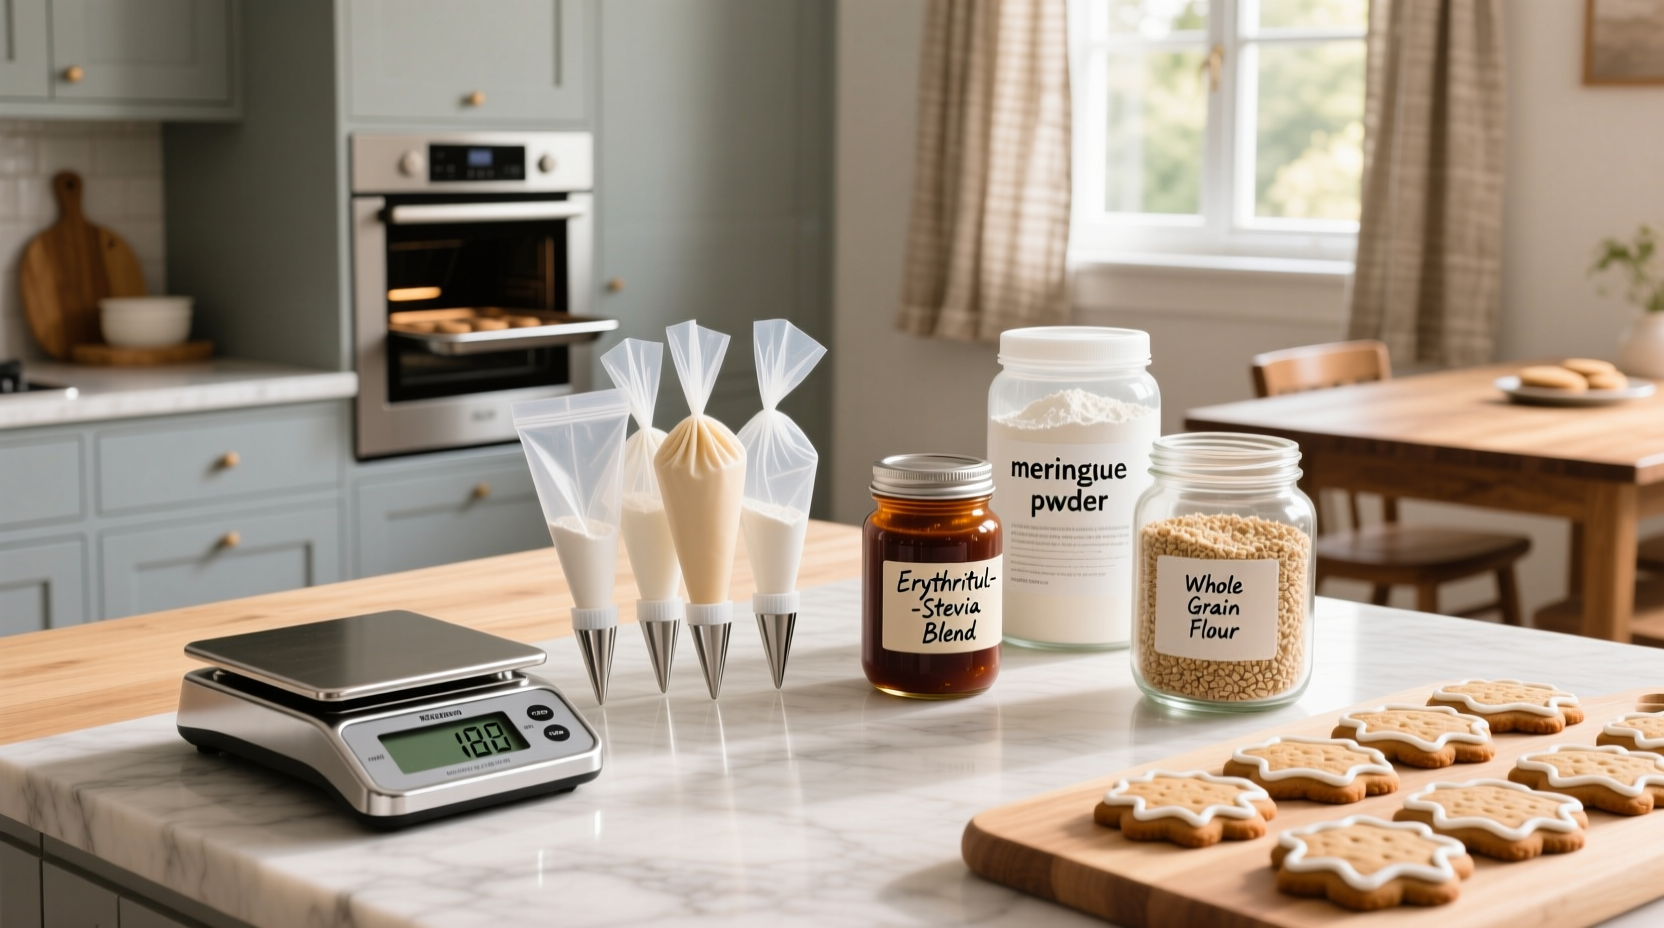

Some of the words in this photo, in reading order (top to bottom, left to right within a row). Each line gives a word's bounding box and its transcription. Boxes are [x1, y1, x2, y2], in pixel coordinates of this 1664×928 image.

[1031, 488, 1109, 518] pwder
[1185, 573, 1244, 595] Whole
[911, 597, 982, 619] -Stevia
[1187, 595, 1240, 616] Grain
[922, 619, 977, 644] Blend
[1189, 618, 1240, 639] Flour
